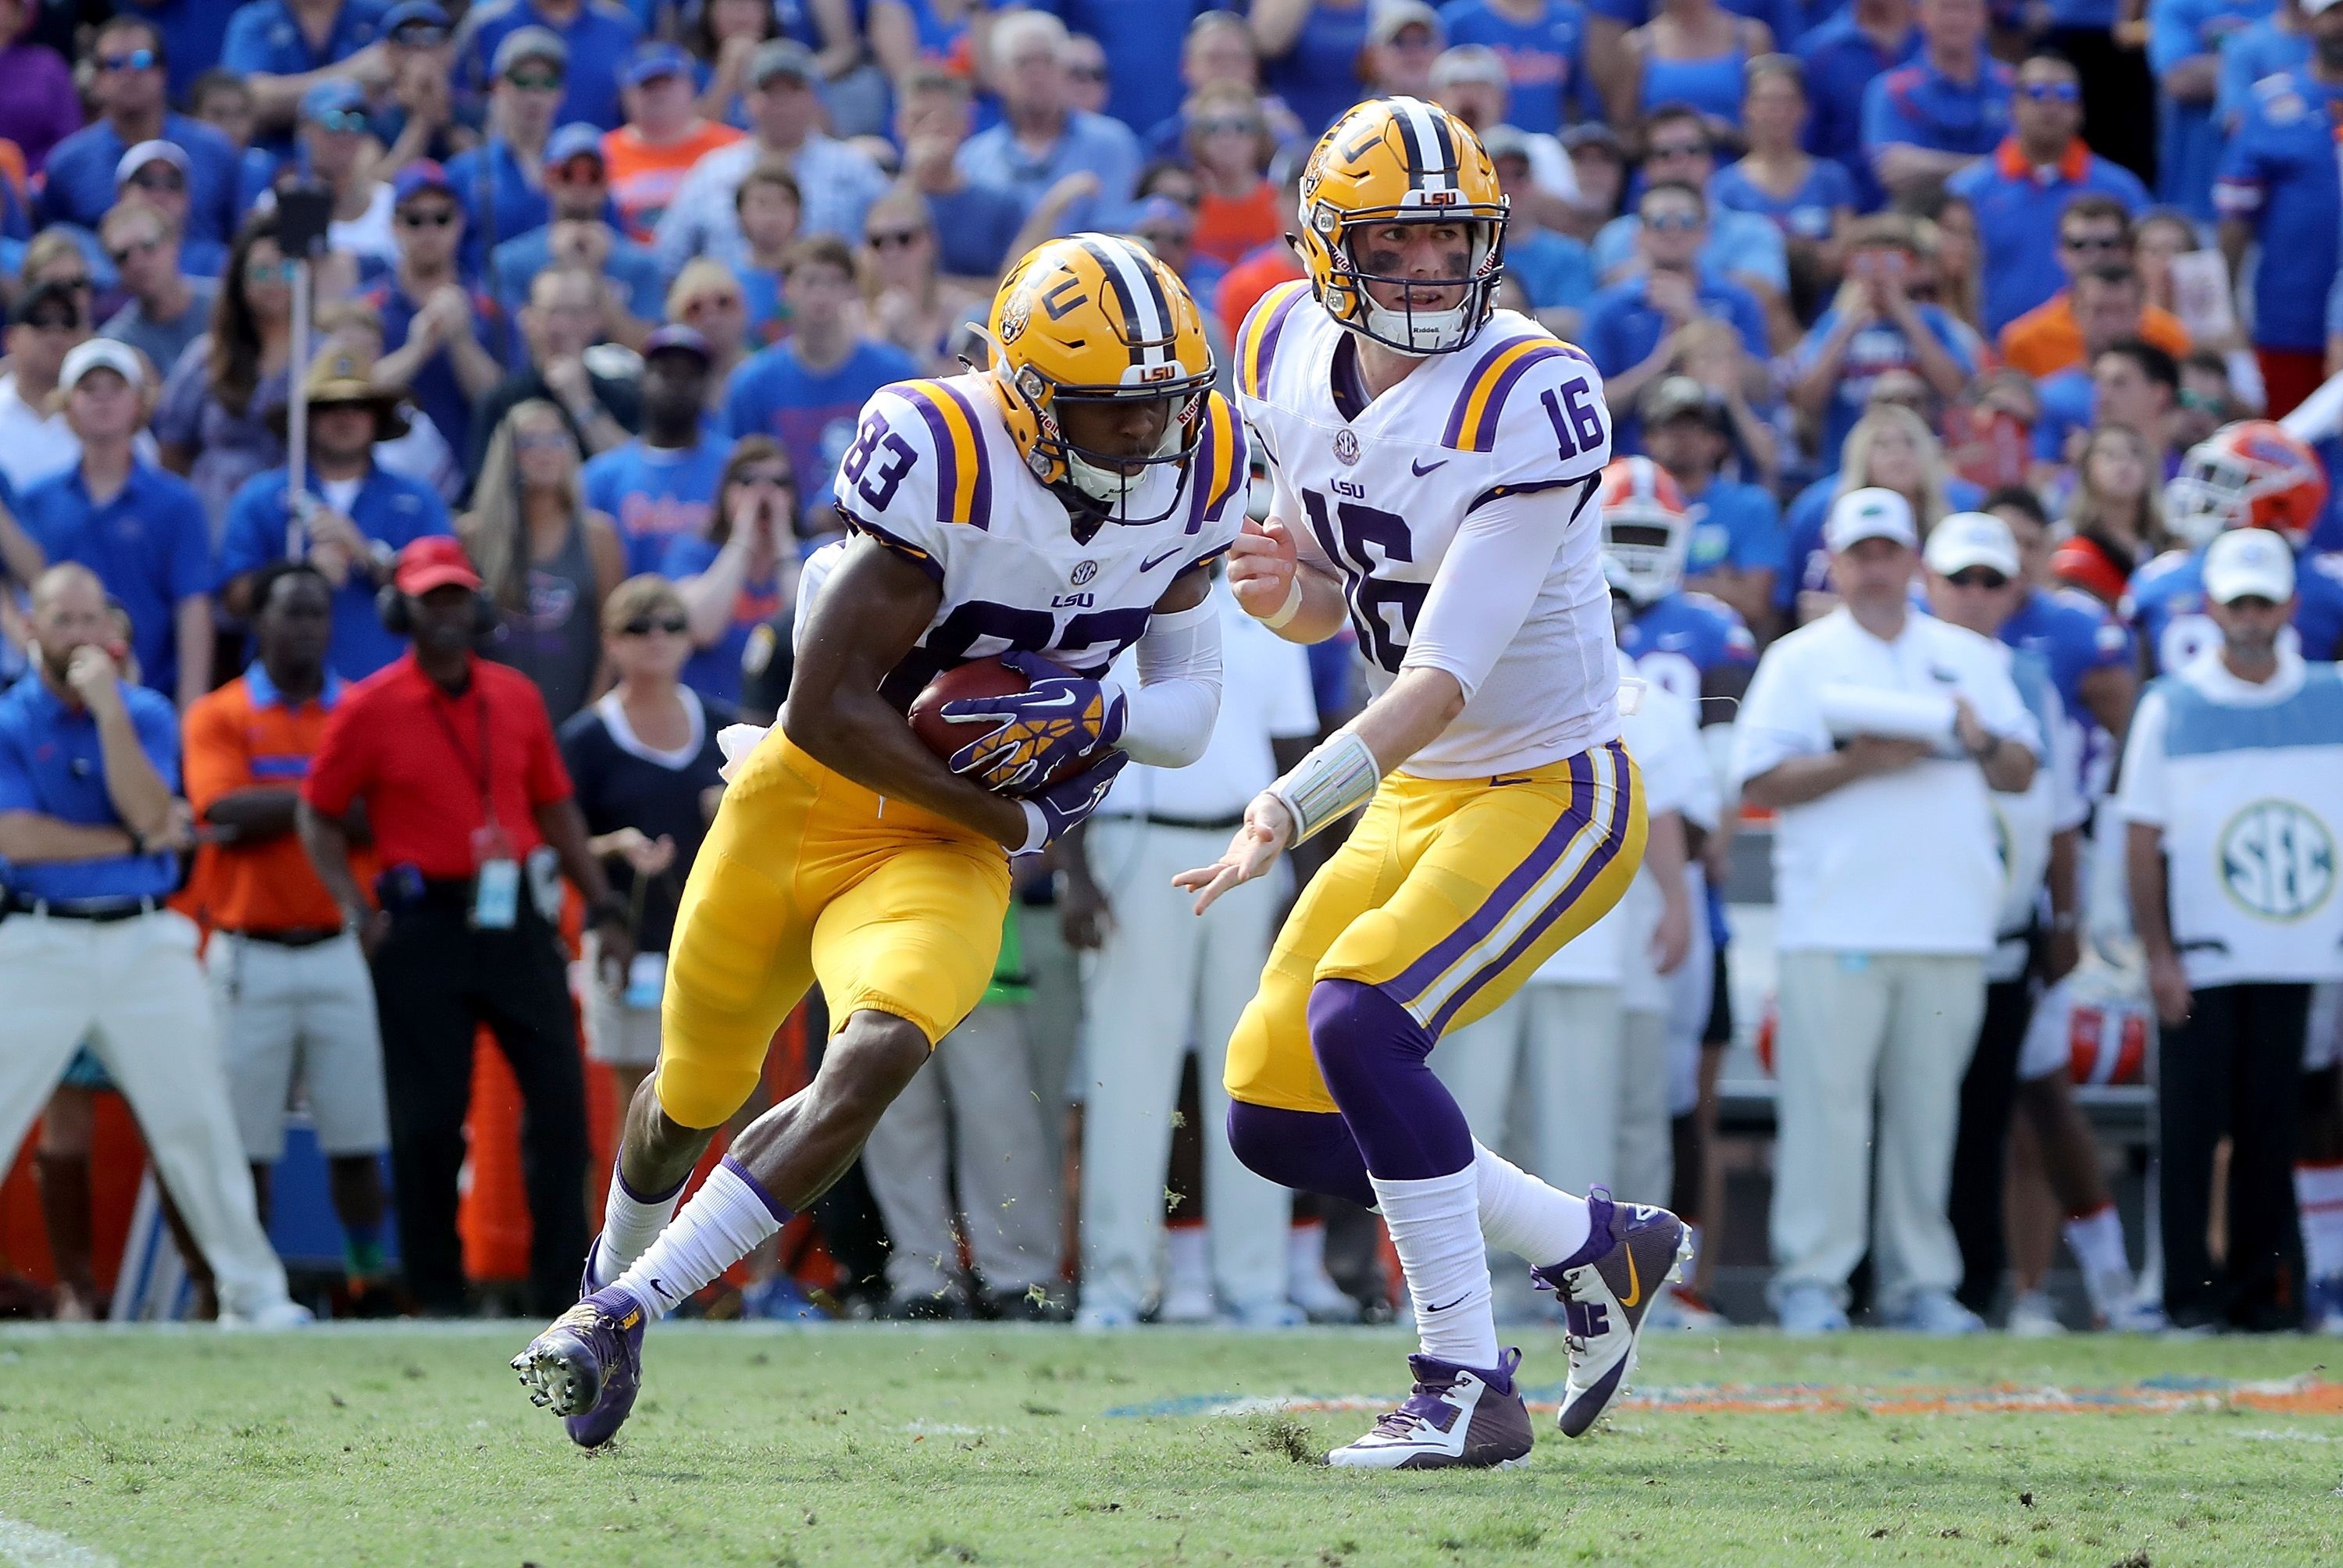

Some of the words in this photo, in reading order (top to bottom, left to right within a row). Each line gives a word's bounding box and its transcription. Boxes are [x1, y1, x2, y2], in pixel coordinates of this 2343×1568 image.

[1420, 192, 1457, 205] LSU
[1139, 365, 1175, 382] LSU
[1541, 376, 1604, 461] 16
[843, 409, 918, 512] 83
[1330, 478, 1364, 499] LSU
[1050, 593, 1094, 608] LSU
[1302, 487, 1432, 675] 16
[2224, 809, 2332, 914] SEC
